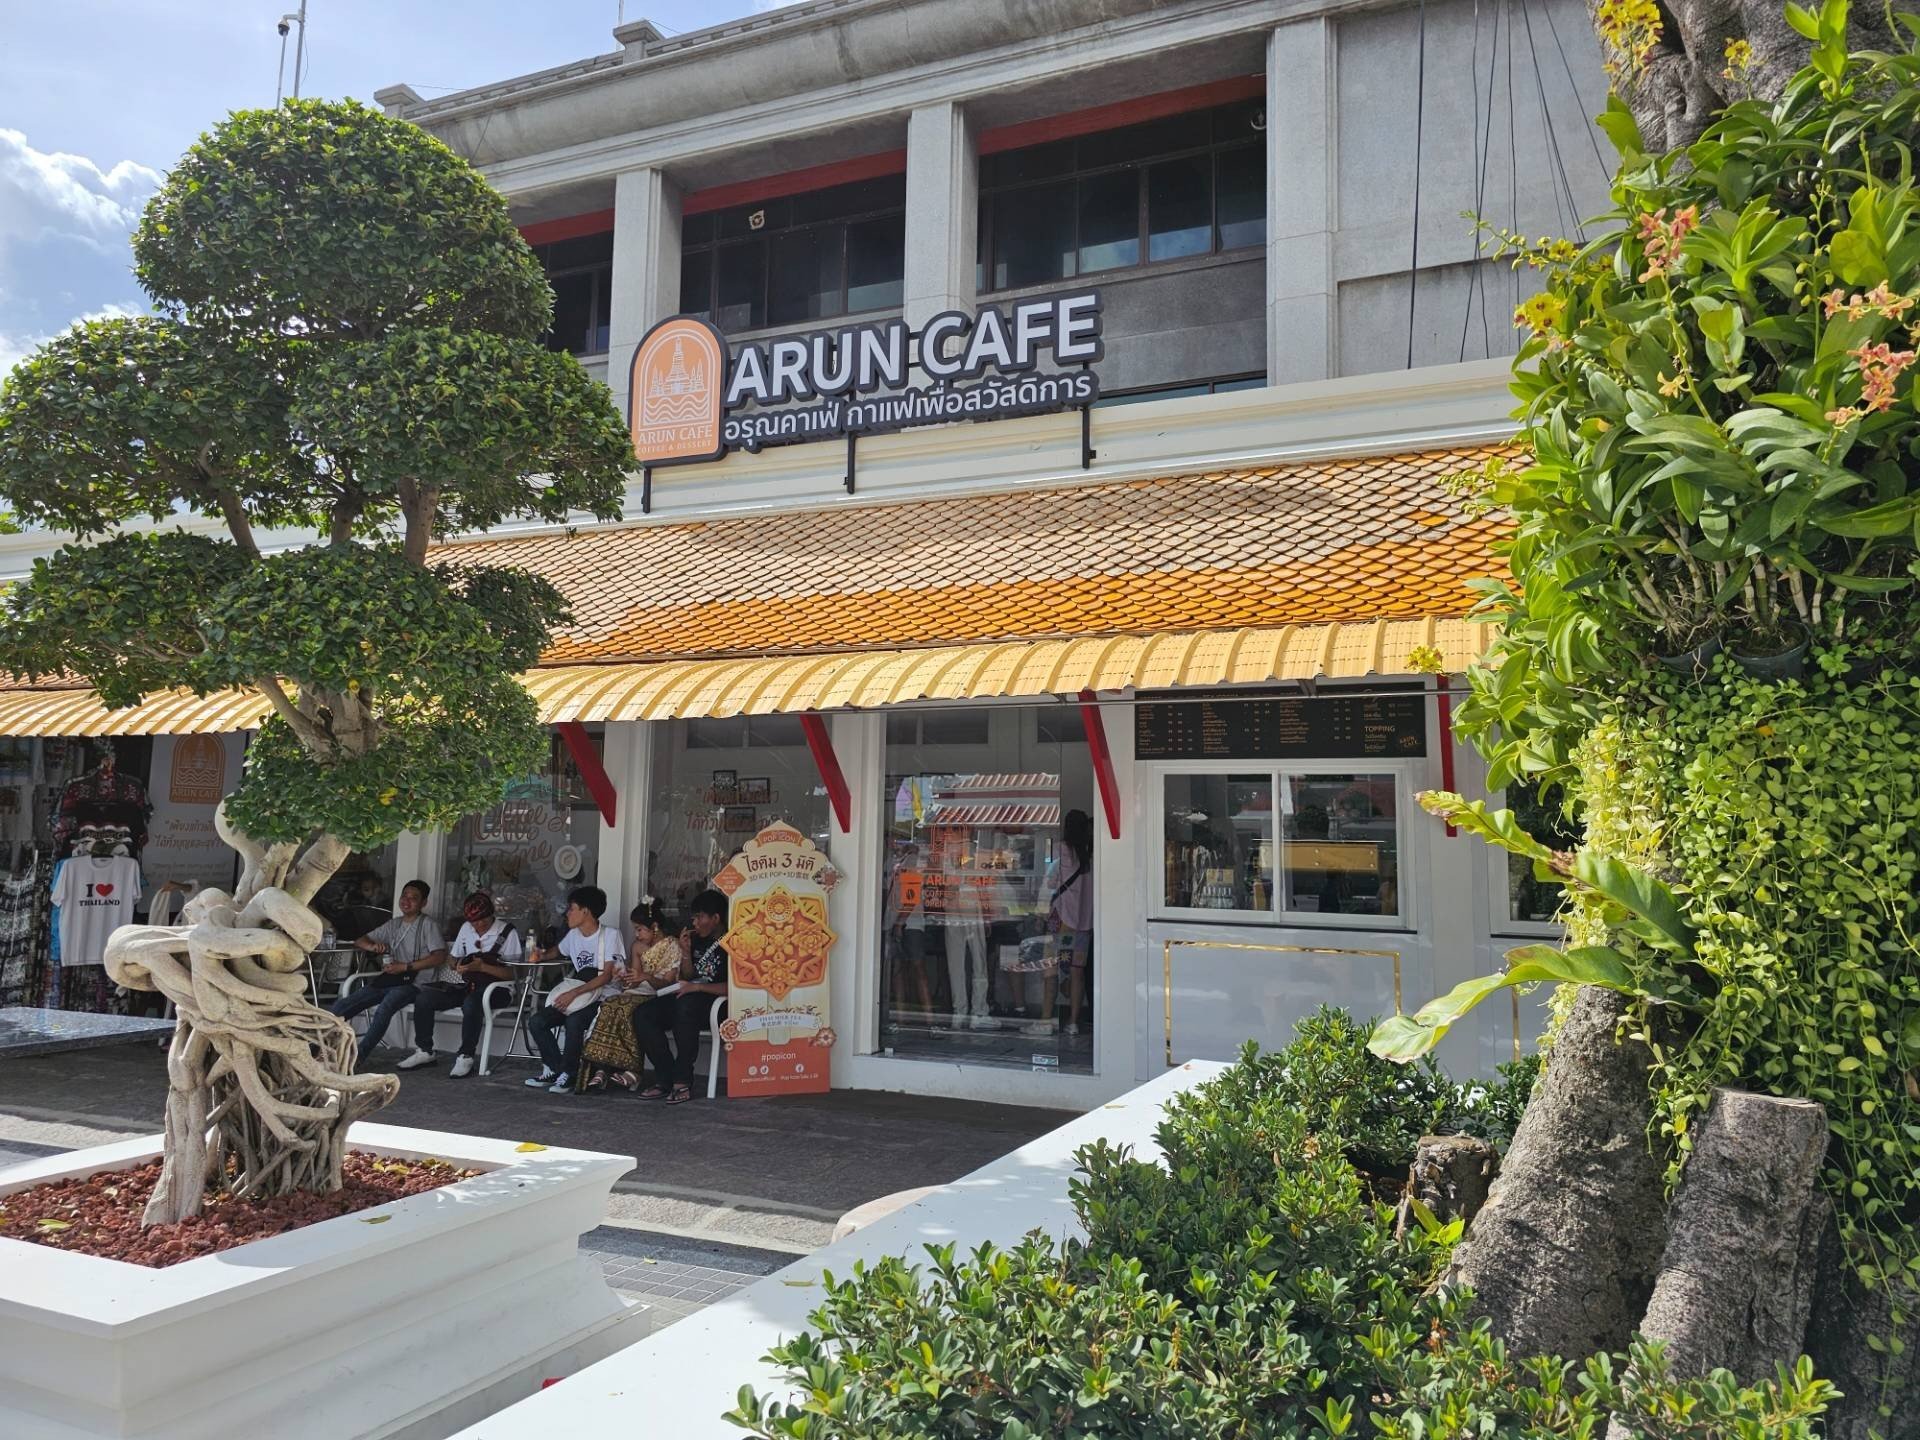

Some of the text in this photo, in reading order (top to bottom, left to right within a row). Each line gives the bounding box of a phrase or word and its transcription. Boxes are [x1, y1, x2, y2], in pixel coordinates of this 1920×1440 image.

[727, 294, 1096, 403] ARUN CAFE
[724, 375, 1092, 446] อรุณคาเฟ่ กาแฟเพื่อสวัสดิการ
[638, 424, 713, 444] ARUN CAFE
[676, 439, 712, 449] DESSERT
[1364, 725, 1396, 733] TOPPING
[782, 853, 793, 868] 3
[86, 883, 95, 898] I
[79, 898, 120, 907] THAILAND
[761, 1052, 796, 1062] #popicon
